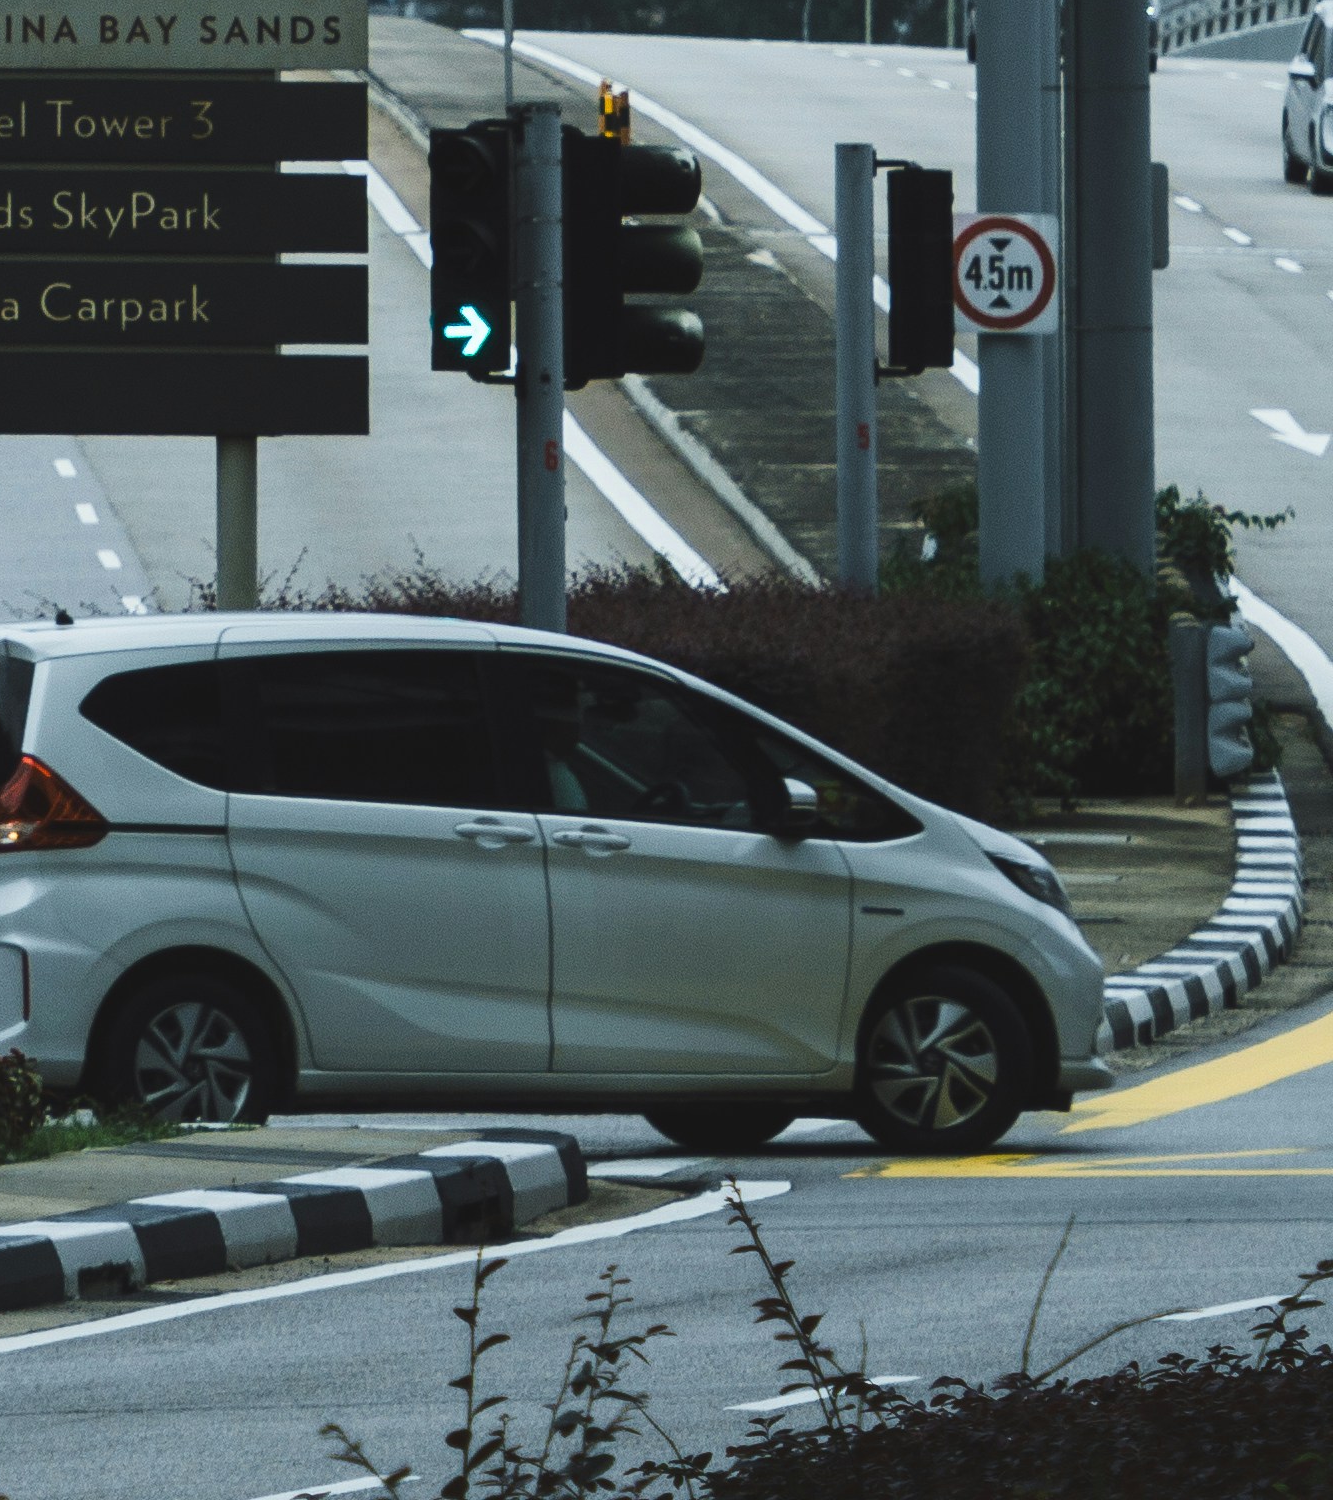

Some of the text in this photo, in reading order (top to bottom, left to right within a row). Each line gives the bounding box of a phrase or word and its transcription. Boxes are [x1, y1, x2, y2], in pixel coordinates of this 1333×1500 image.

[99, 16, 179, 45] BAY
[199, 16, 343, 45] SANDS
[45, 99, 173, 140] Tower
[190, 99, 214, 140] 3
[52, 190, 222, 238] SkyPark
[965, 257, 1033, 292] 4.5m
[39, 282, 211, 331] Carpark
[544, 439, 559, 472] 6
